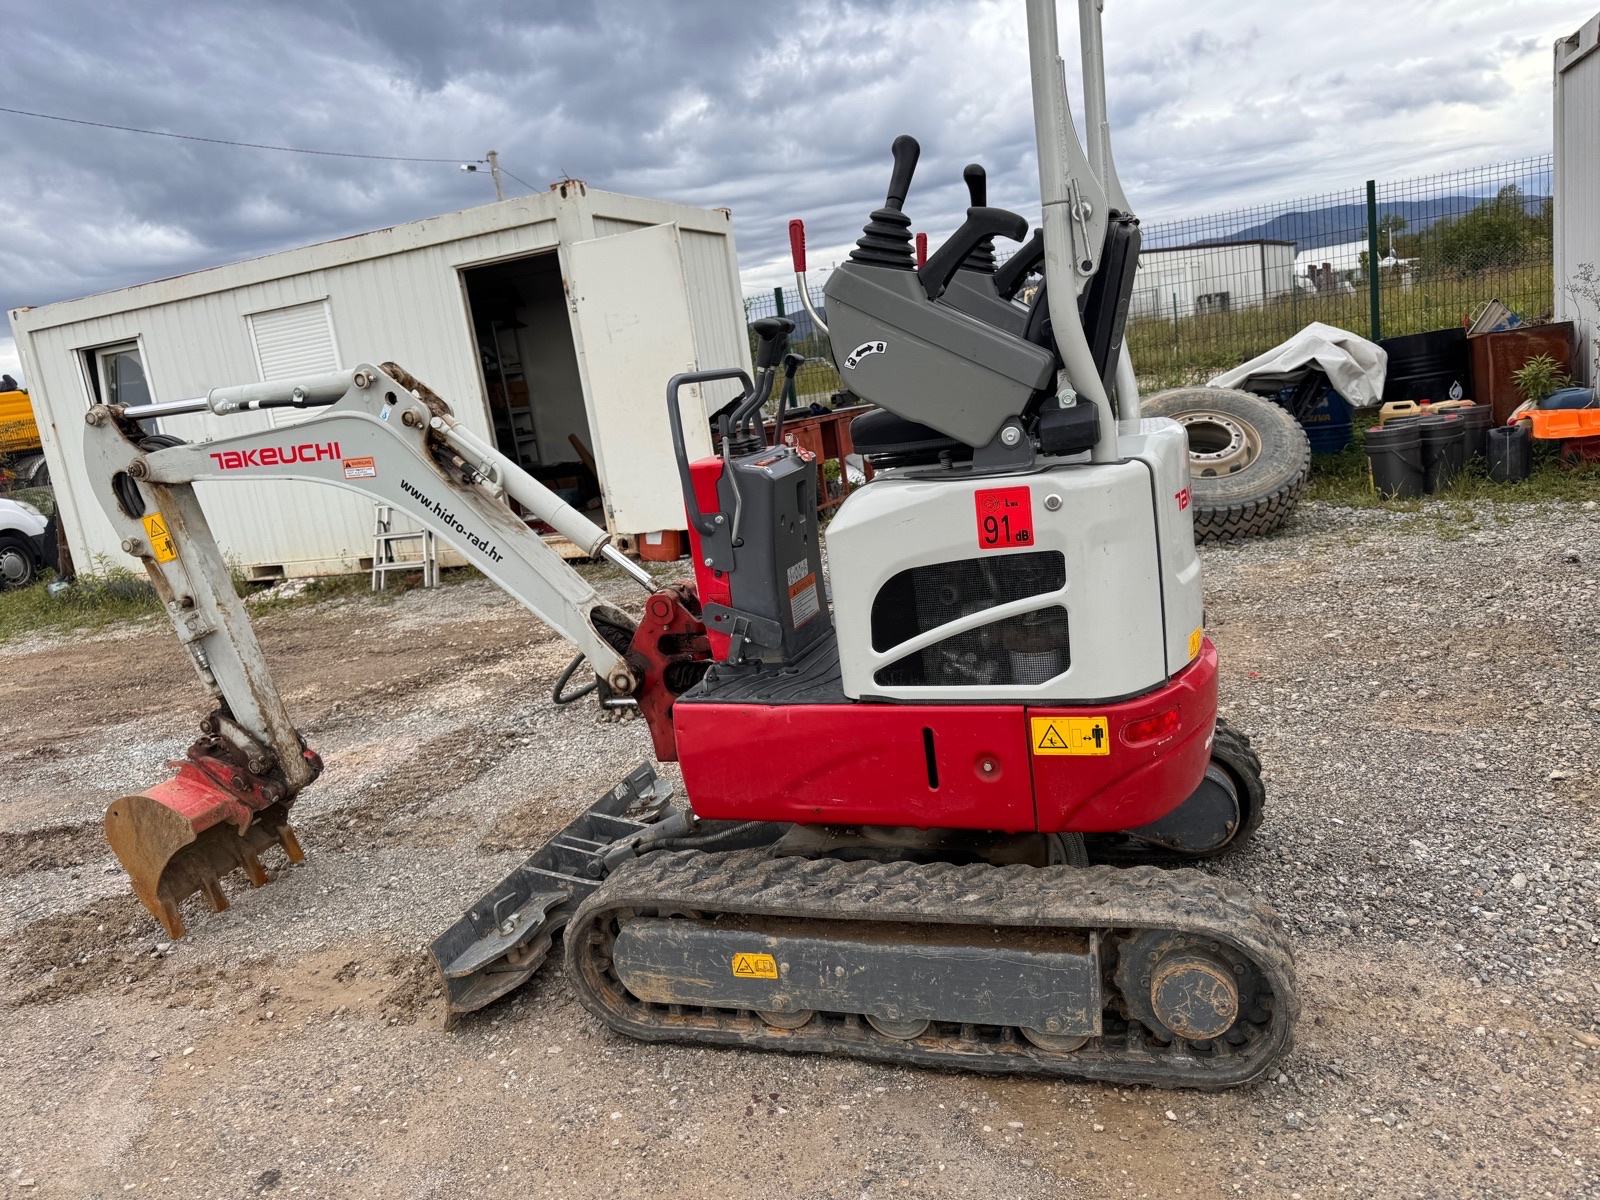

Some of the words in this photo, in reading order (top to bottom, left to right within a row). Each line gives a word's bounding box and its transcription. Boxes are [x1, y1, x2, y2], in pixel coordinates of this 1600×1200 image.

[210, 441, 341, 470] TAKEUCHI
[400, 479, 503, 563] www.hidro-rad.hr
[983, 515, 1010, 544] 91
[1016, 529, 1029, 541] dB
